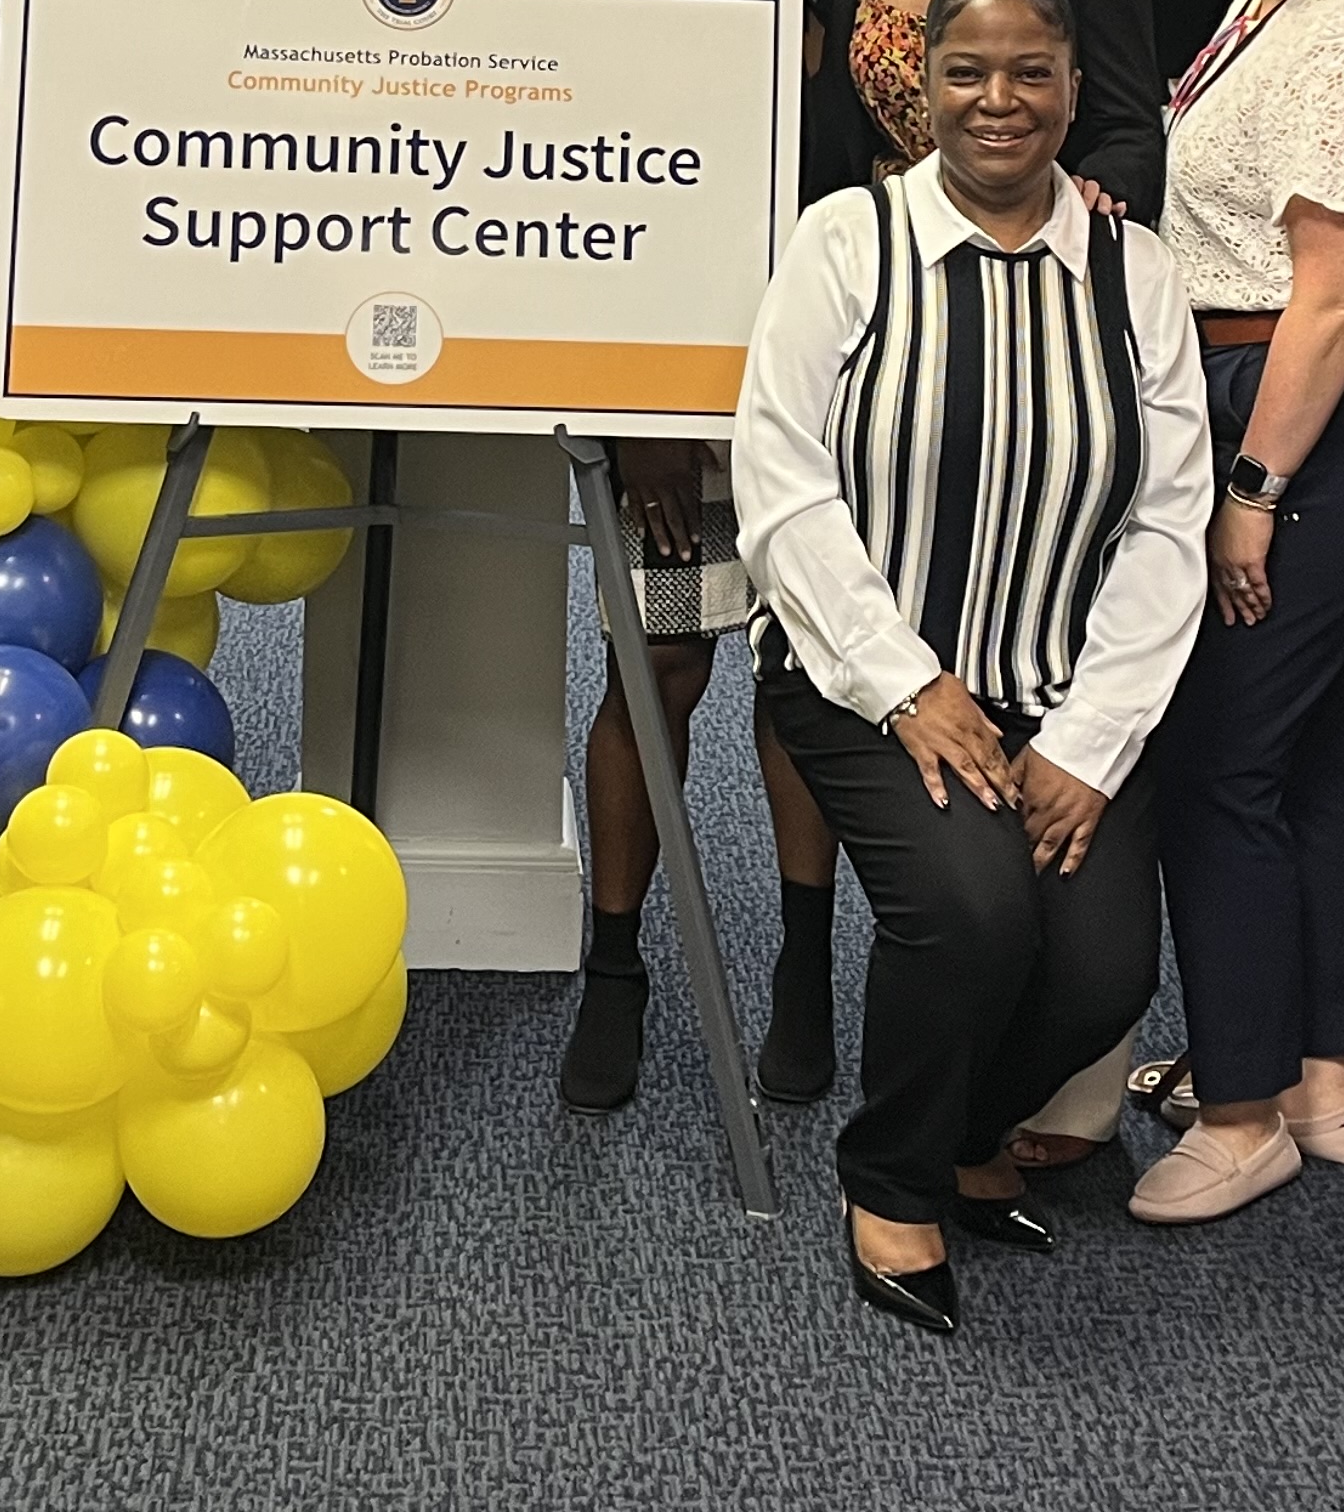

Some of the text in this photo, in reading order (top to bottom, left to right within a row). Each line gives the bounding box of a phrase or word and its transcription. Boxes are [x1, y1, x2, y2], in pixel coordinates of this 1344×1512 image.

[244, 44, 559, 72] Massachusetts Probation Service
[227, 69, 574, 105] Community Justice Programs
[90, 115, 701, 191] Community Justice
[142, 196, 648, 264] Support Center
